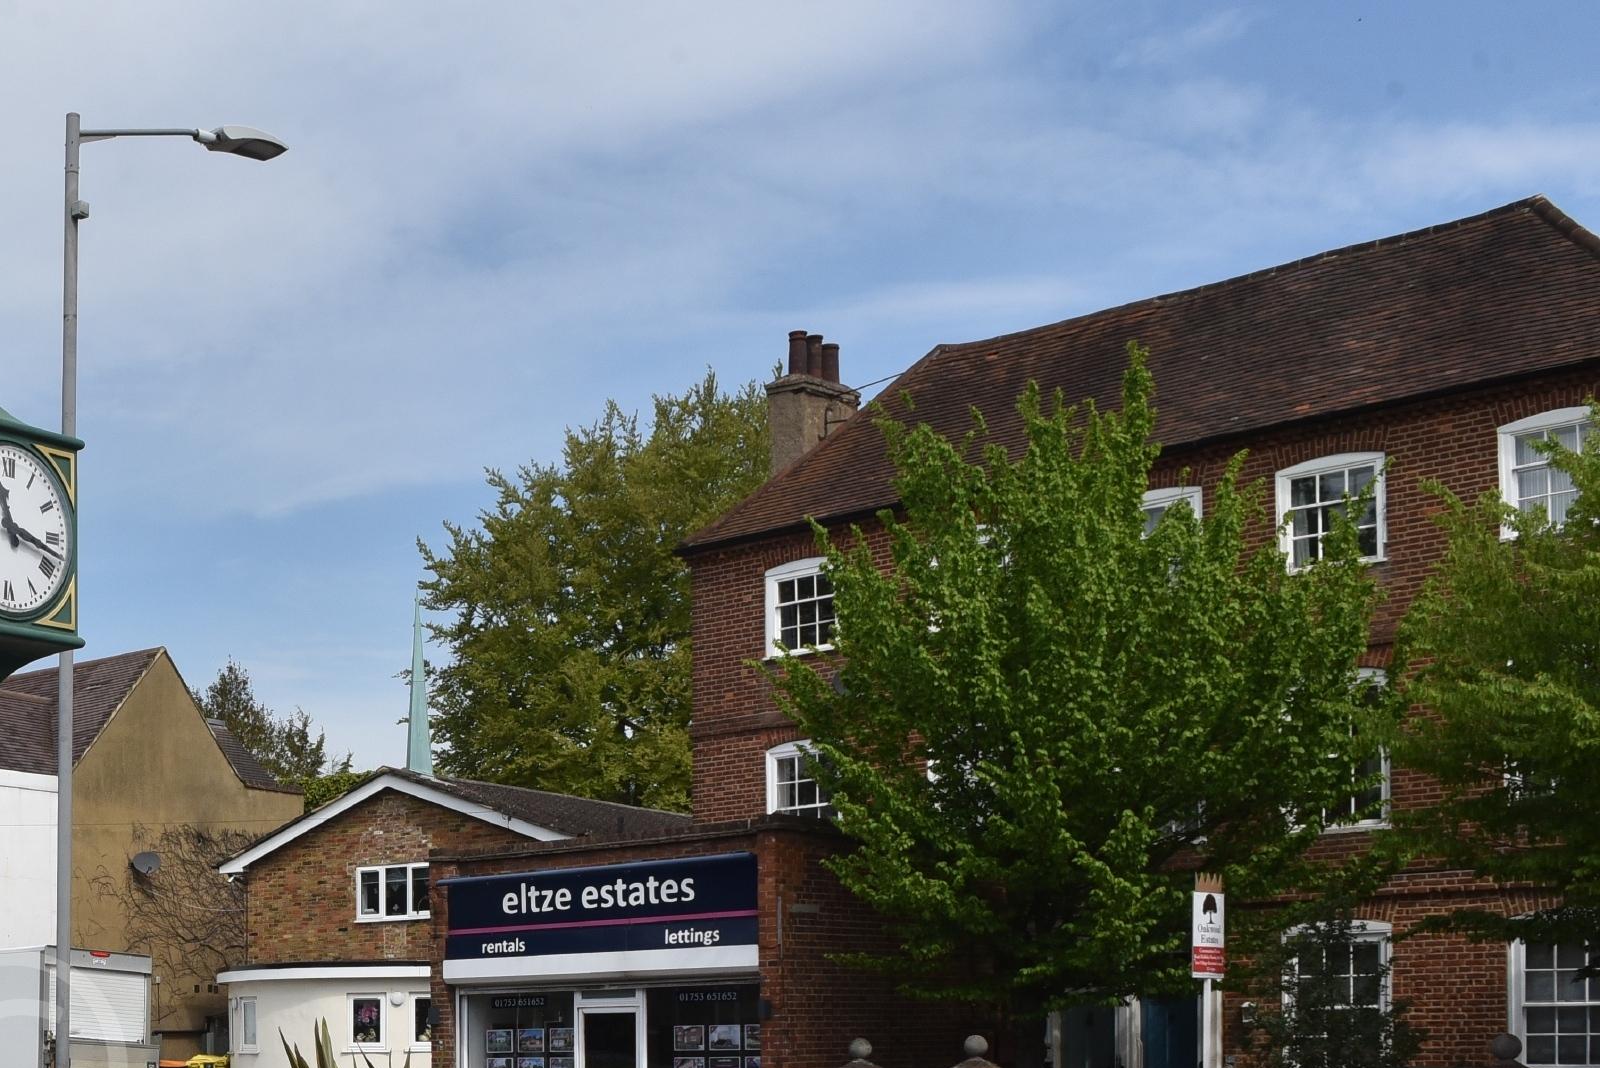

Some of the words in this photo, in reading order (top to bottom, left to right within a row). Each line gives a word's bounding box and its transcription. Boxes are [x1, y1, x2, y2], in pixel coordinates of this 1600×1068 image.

[2, 457, 15, 479] XII
[26, 473, 35, 490] I
[40, 500, 54, 514] II
[46, 531, 59, 546] III
[4, 580, 15, 601] VI
[27, 576, 37, 598] V
[502, 882, 572, 914] eltze
[581, 876, 695, 909] estates
[664, 928, 720, 946] lettings
[481, 938, 526, 954] rentals
[495, 999, 517, 1007] 01753
[680, 993, 704, 1002] 01753
